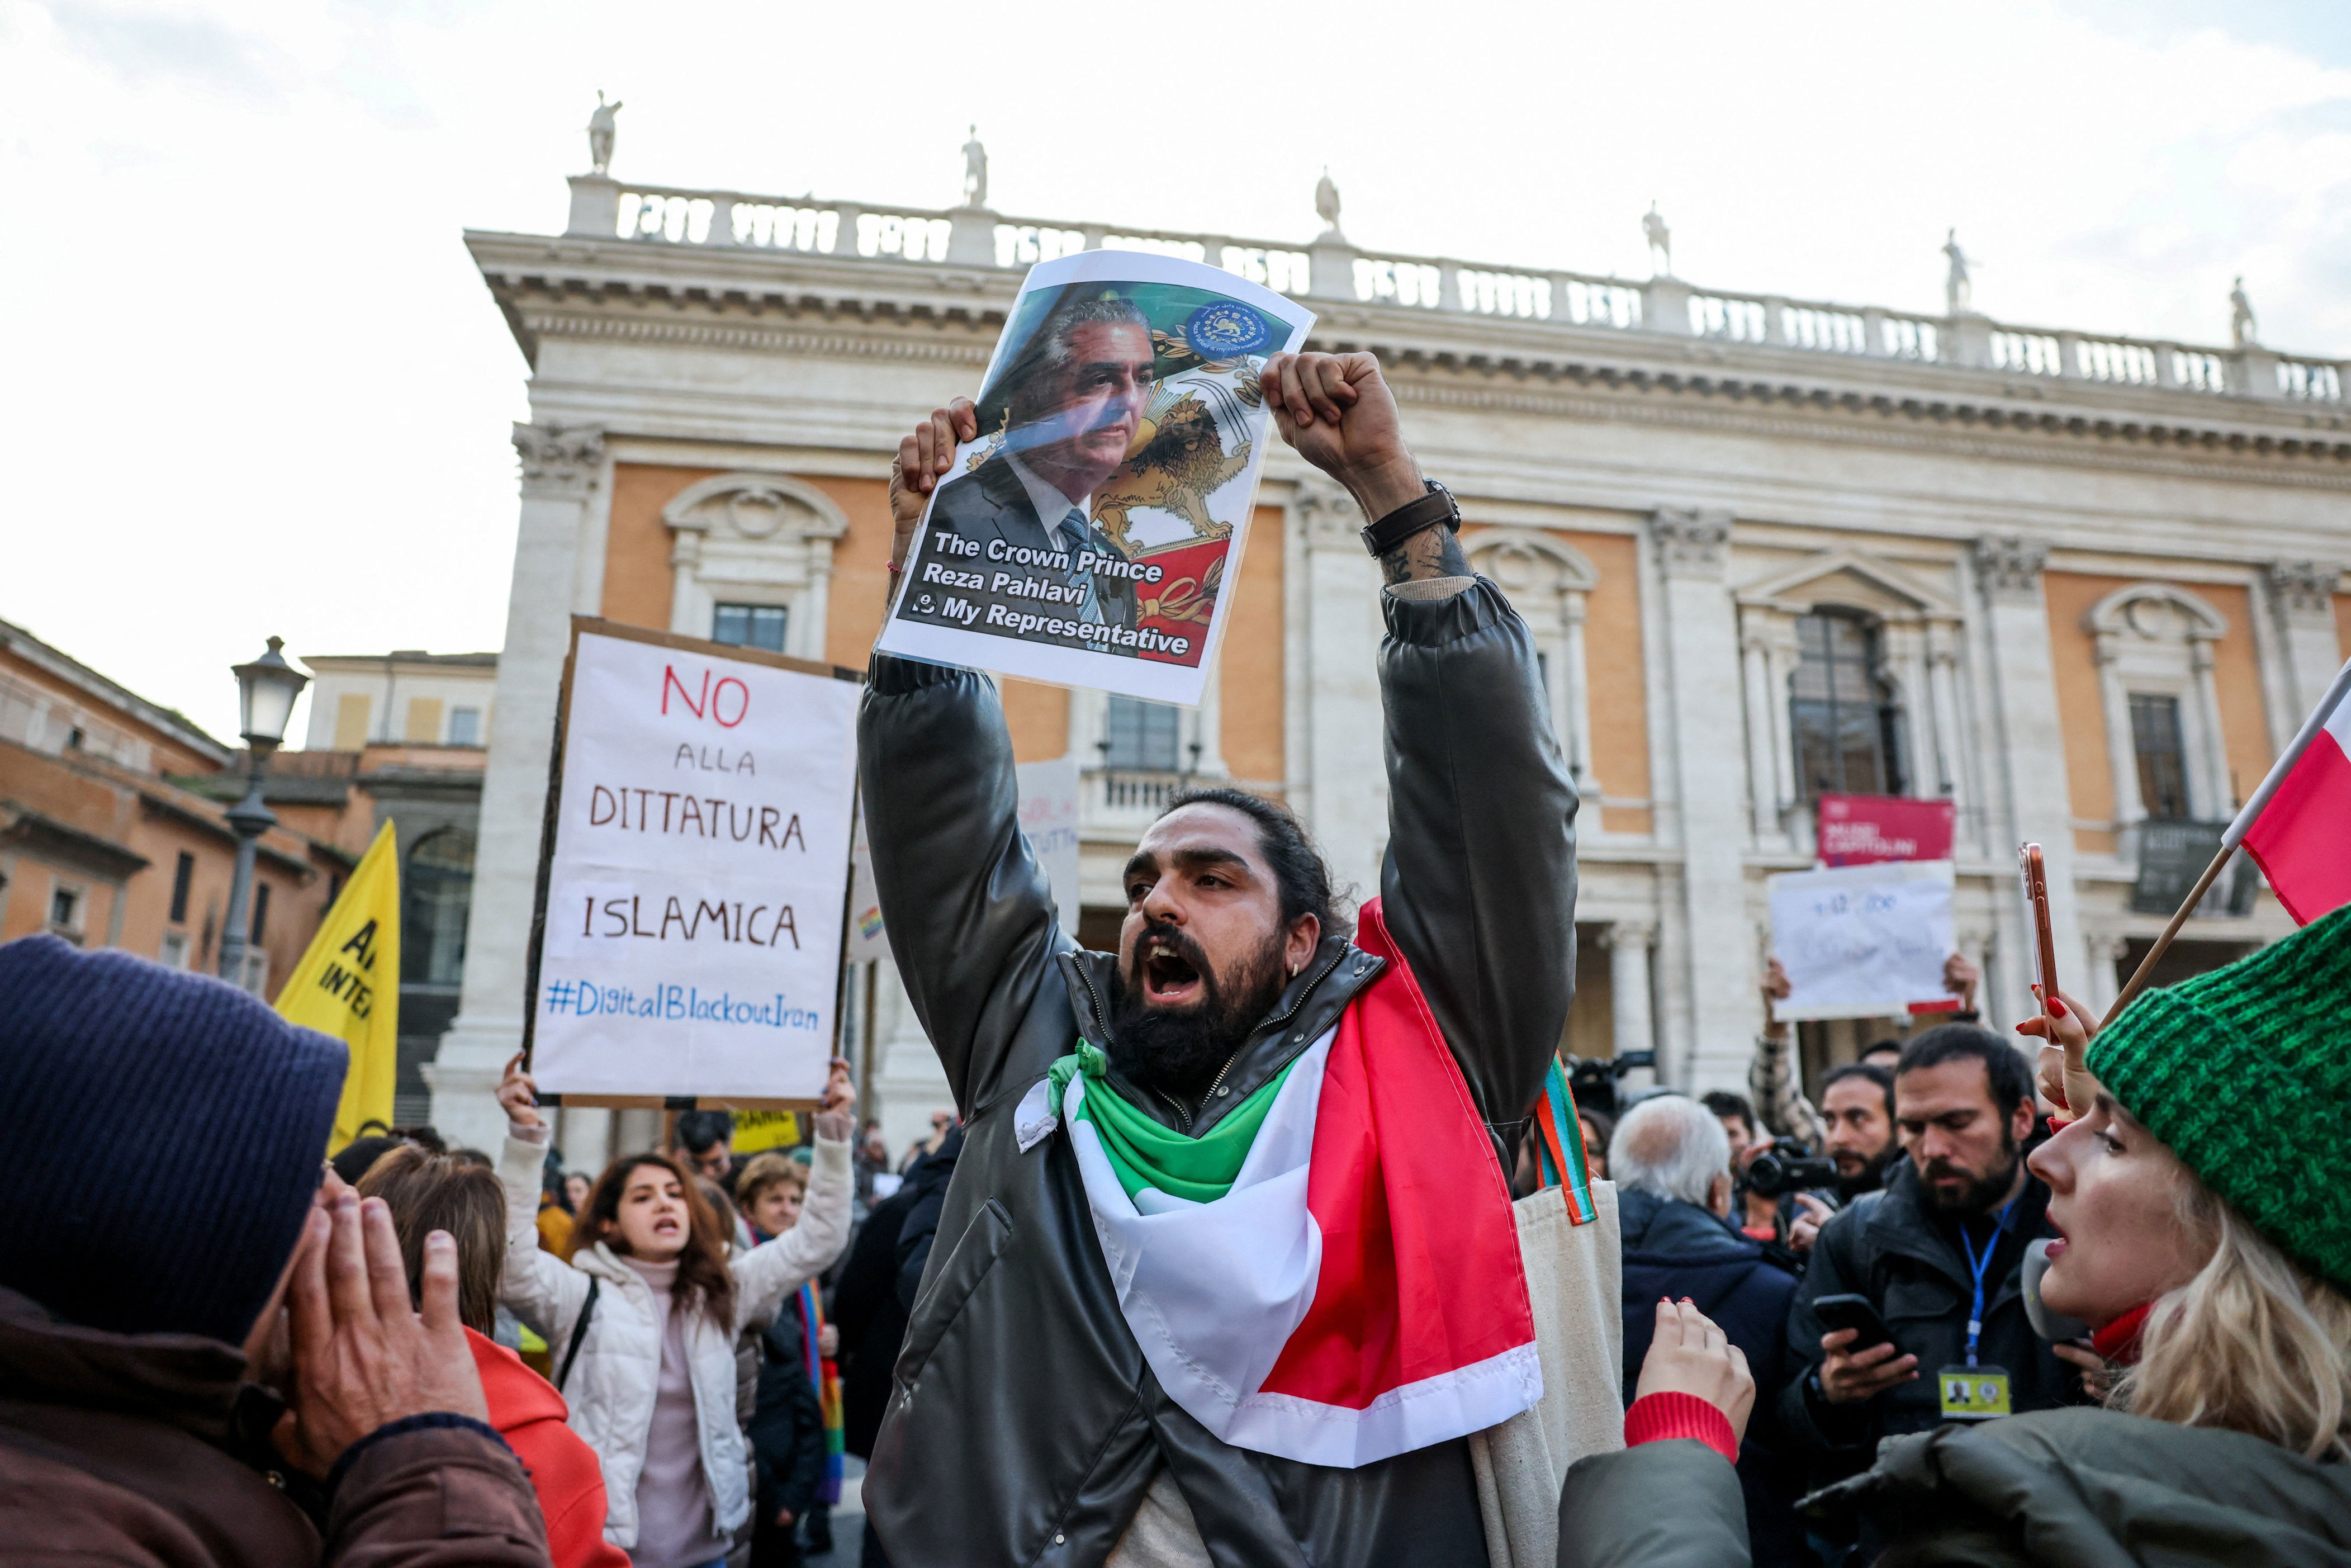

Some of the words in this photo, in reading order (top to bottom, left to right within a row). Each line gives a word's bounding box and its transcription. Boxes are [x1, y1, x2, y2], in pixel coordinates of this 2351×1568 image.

[1228, 337, 1264, 352] representative
[923, 562, 984, 590] Reza
[990, 572, 1087, 605] Pahlavi
[935, 532, 980, 557] The
[987, 539, 1069, 570] Crown
[1077, 551, 1163, 582] Prince
[942, 596, 982, 625] My
[985, 603, 1189, 655] Representative
[662, 665, 749, 728] NO
[674, 743, 756, 776] ALLA
[590, 785, 805, 852] DITTATURA
[582, 895, 800, 950] ISLAMICA
[545, 978, 819, 1031] #DigitalBlackoutIran
